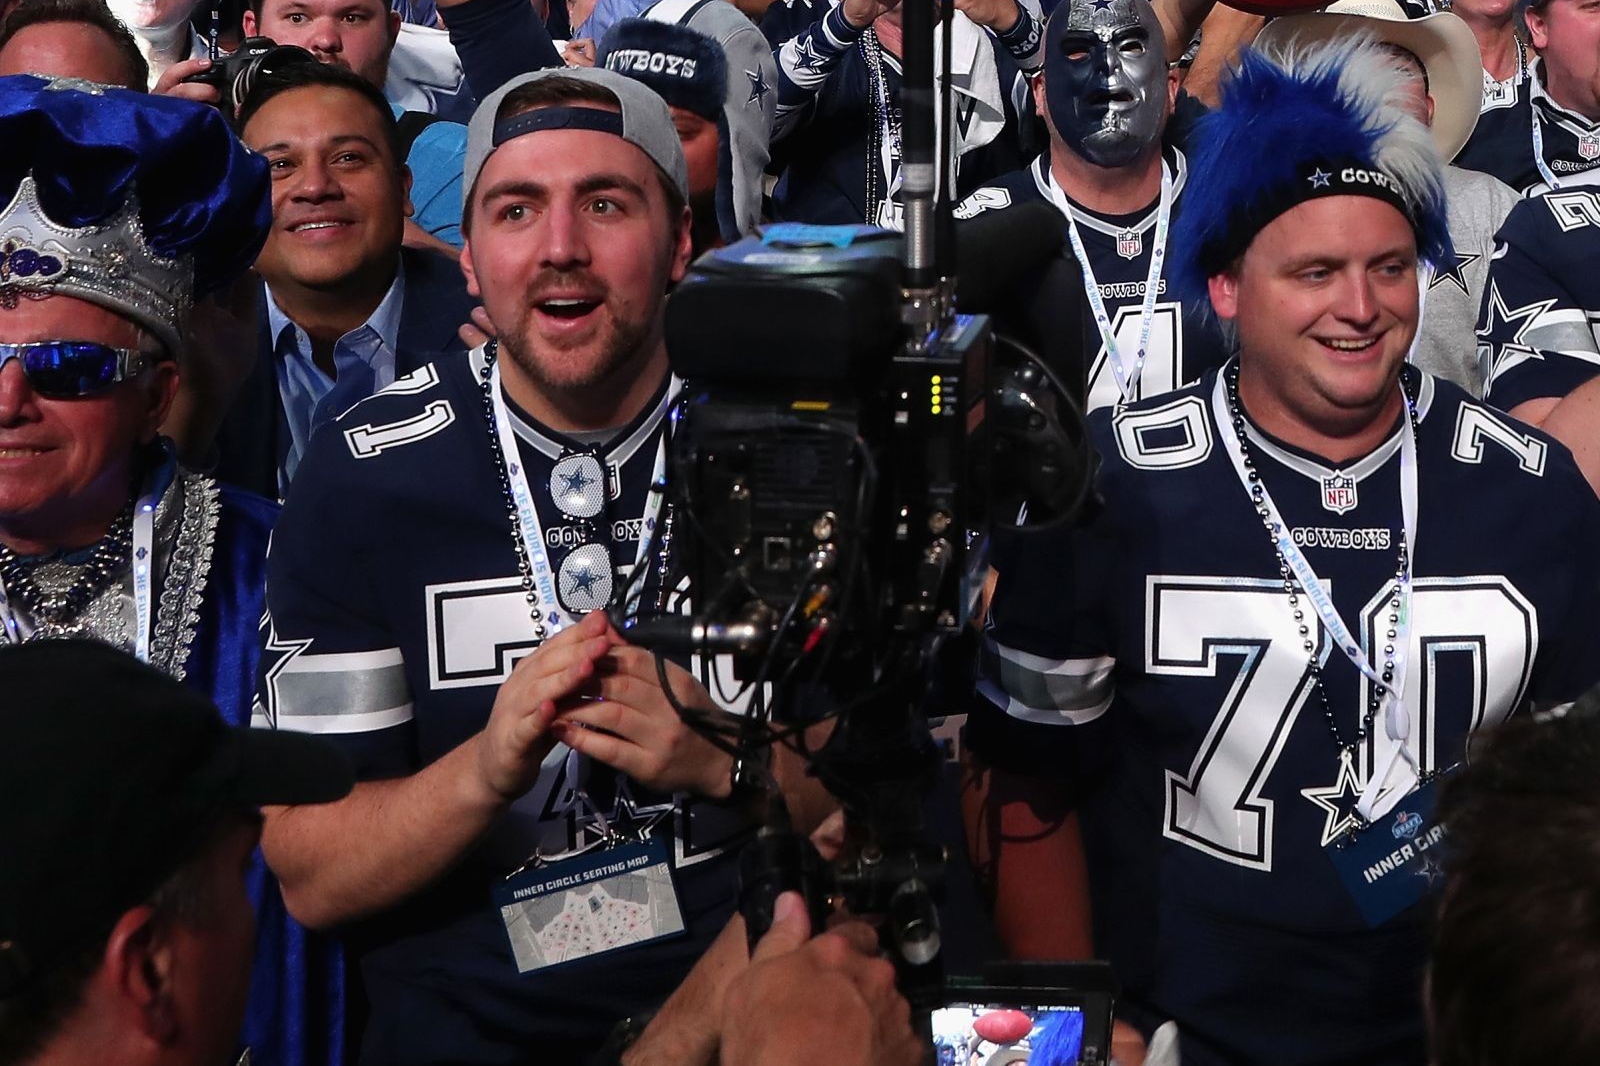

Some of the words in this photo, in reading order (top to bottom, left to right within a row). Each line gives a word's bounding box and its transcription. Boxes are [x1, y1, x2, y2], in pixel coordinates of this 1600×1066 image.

[1582, 143, 1598, 155] NFL
[1120, 242, 1139, 254] NFL
[1097, 280, 1167, 299] COWBOS
[1327, 490, 1353, 506] NFL
[1291, 527, 1391, 550] COWBOYS
[538, 576, 556, 605] NOW
[1145, 574, 1539, 873] 70
[1363, 843, 1415, 884] INNER
[513, 884, 545, 900] INNER
[546, 875, 582, 891] CIRCLE
[583, 863, 627, 881] SEATING
[627, 854, 650, 869] MAP
